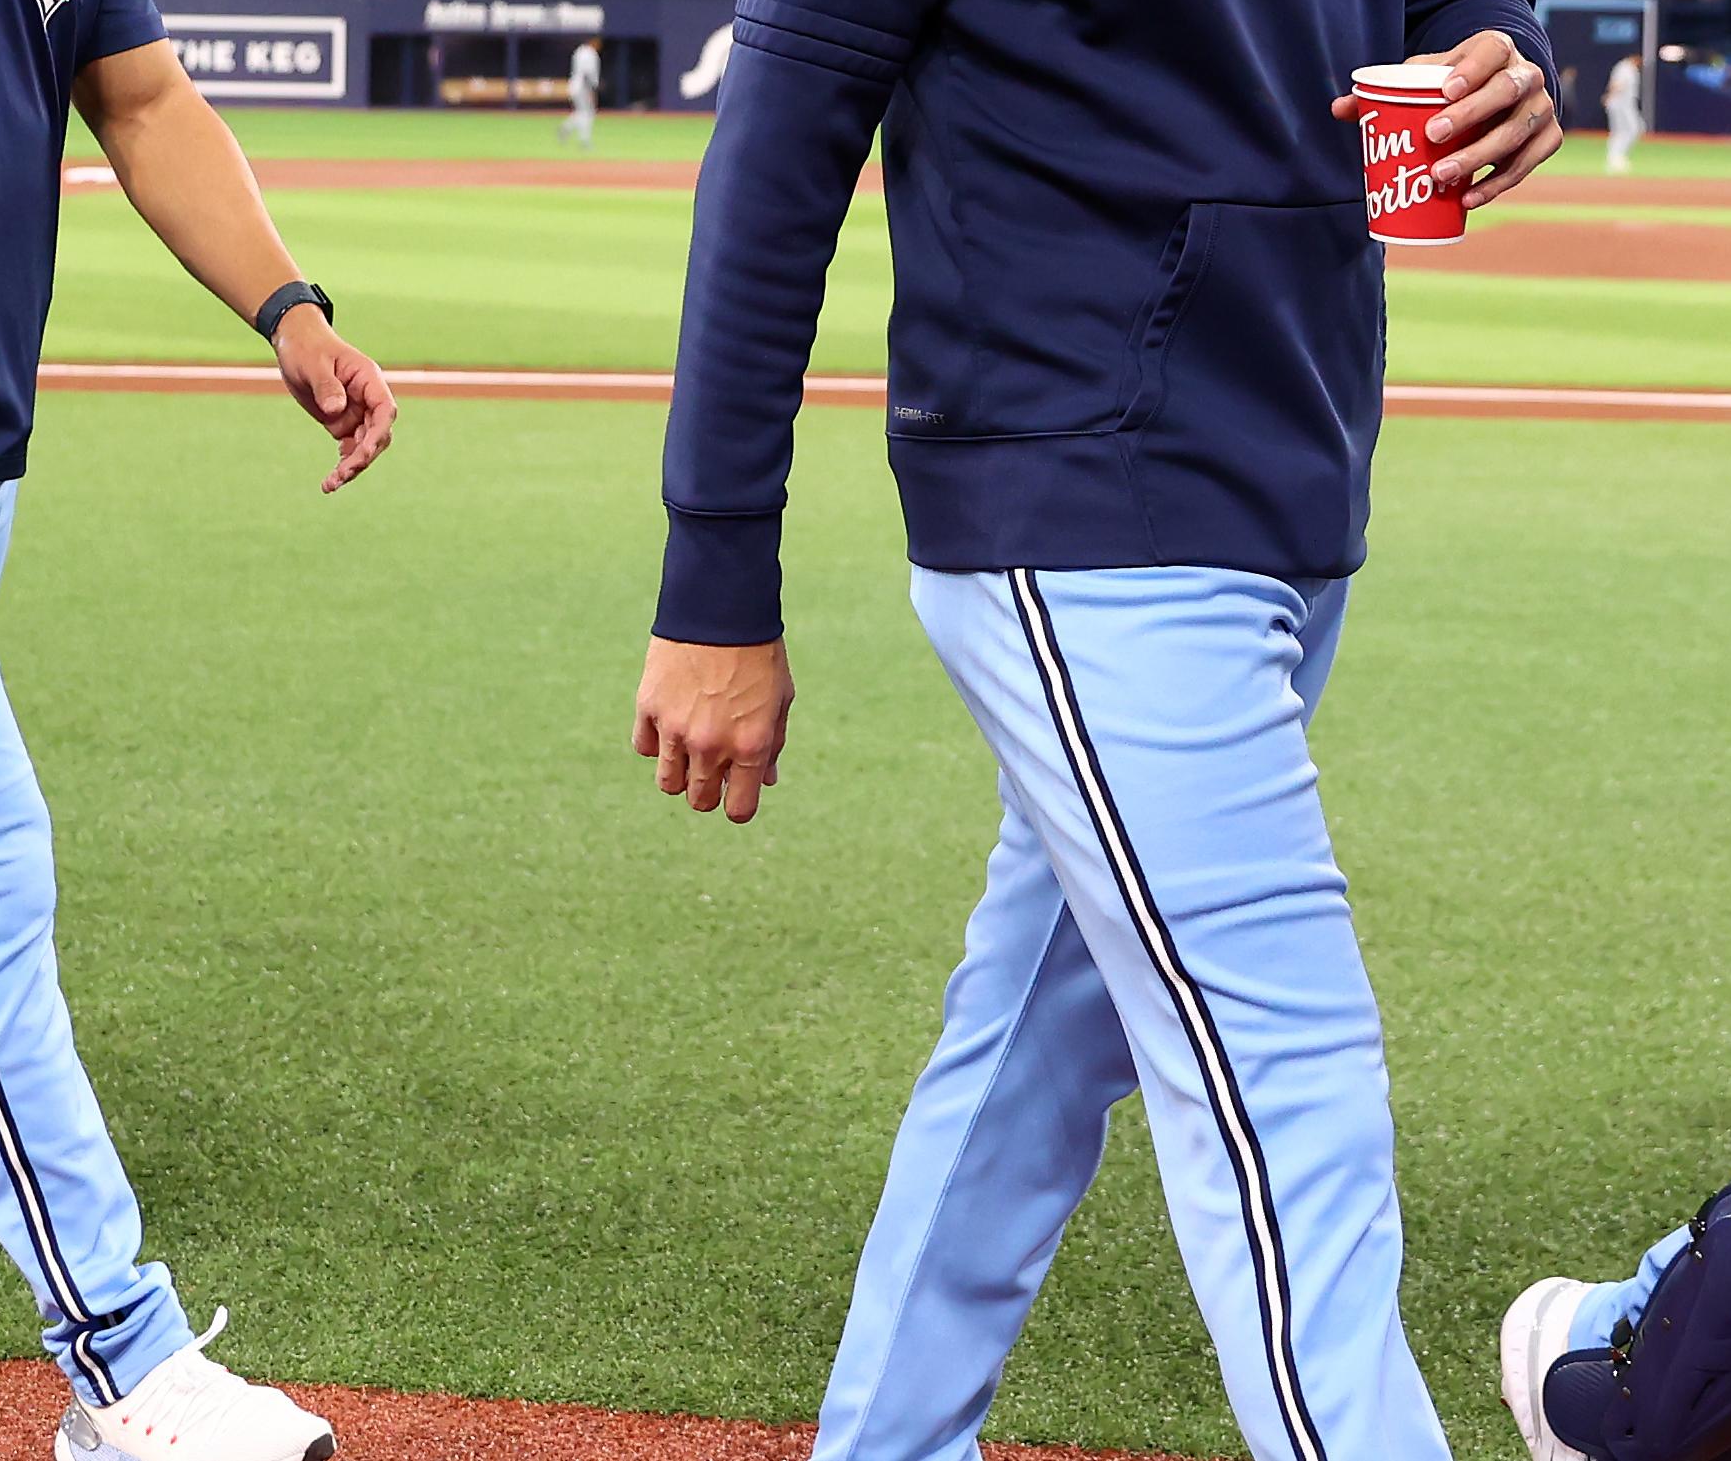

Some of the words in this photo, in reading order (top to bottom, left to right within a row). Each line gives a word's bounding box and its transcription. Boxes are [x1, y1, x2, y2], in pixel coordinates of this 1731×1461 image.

[246, 40, 322, 74] KEG
[1360, 110, 1416, 168] Tim
[1364, 164, 1437, 223] orto
